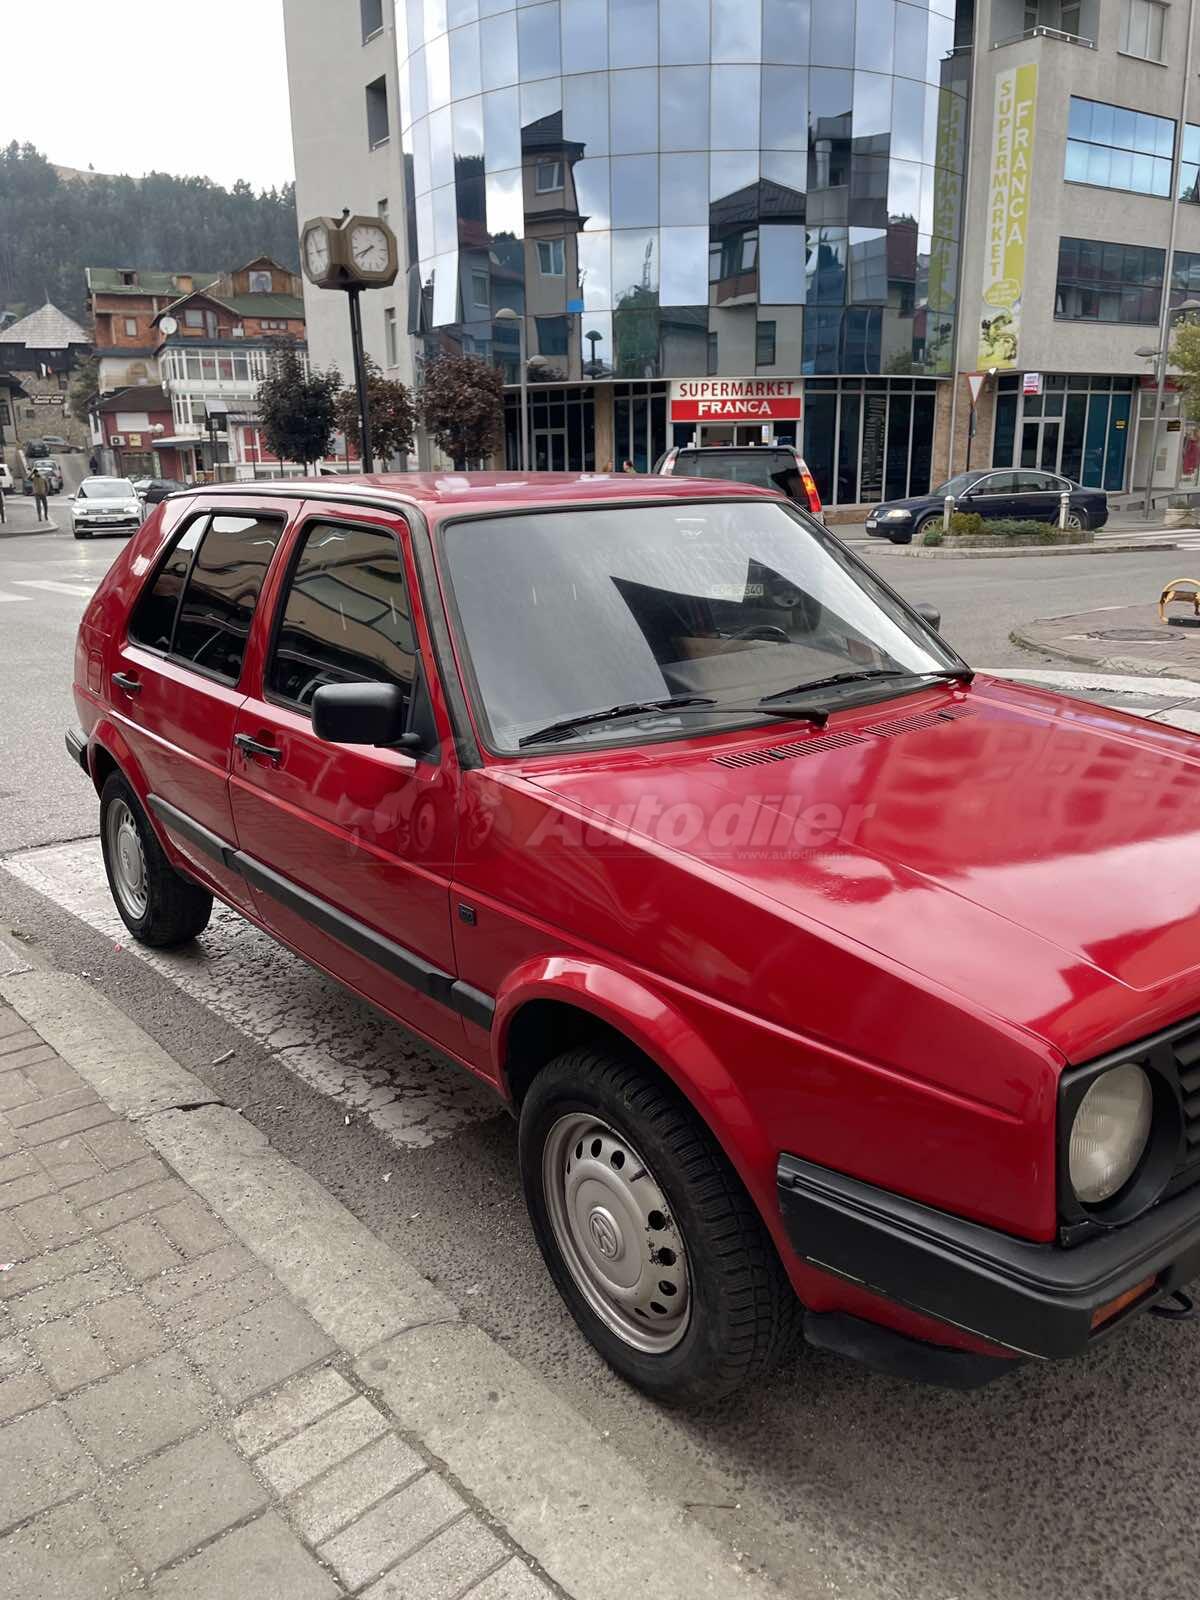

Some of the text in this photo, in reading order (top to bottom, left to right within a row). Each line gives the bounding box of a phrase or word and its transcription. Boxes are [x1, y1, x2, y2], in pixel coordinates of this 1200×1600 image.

[991, 80, 1012, 276] SUPERMARKET
[1006, 101, 1033, 246] FRANCA
[679, 381, 795, 397] SUPERMARKET
[698, 400, 772, 416] FRANCA
